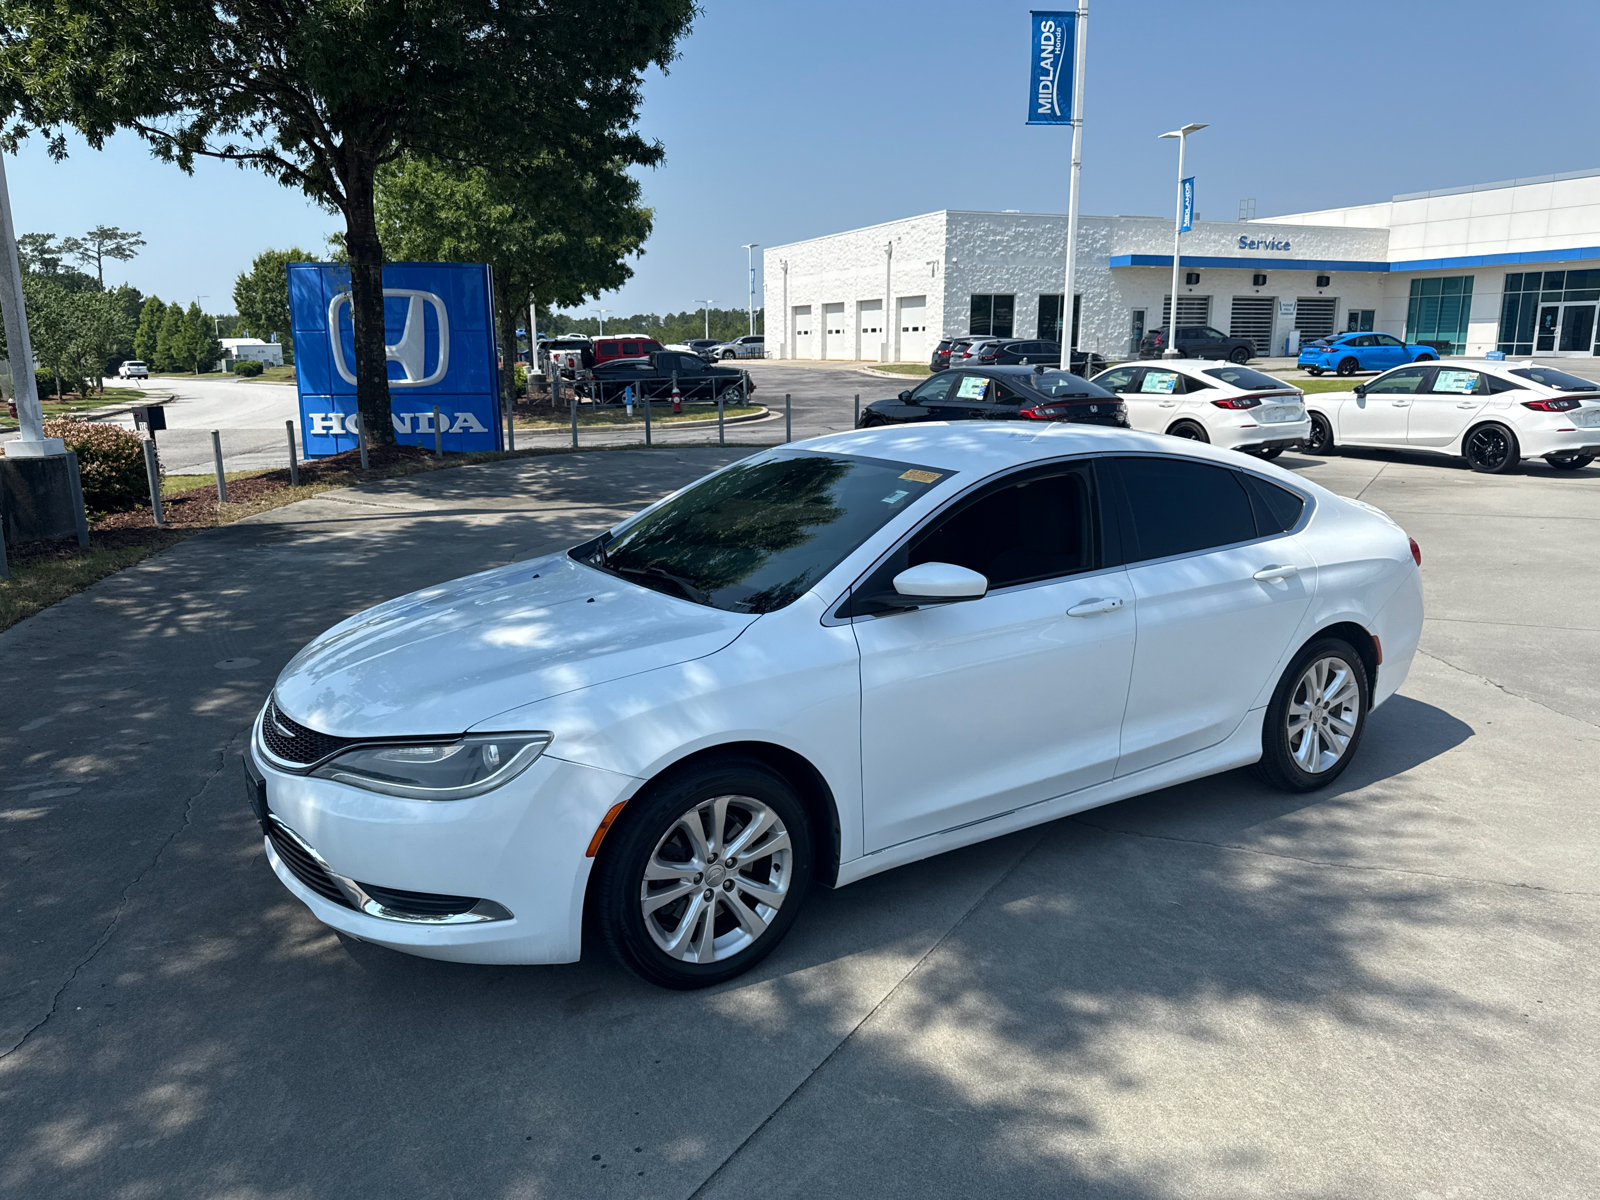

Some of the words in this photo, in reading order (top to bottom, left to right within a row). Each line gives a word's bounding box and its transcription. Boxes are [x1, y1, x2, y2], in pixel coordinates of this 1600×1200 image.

[1054, 27, 1062, 54] Honda
[1037, 20, 1055, 114] MIDLANDS
[1238, 235, 1291, 251] Service
